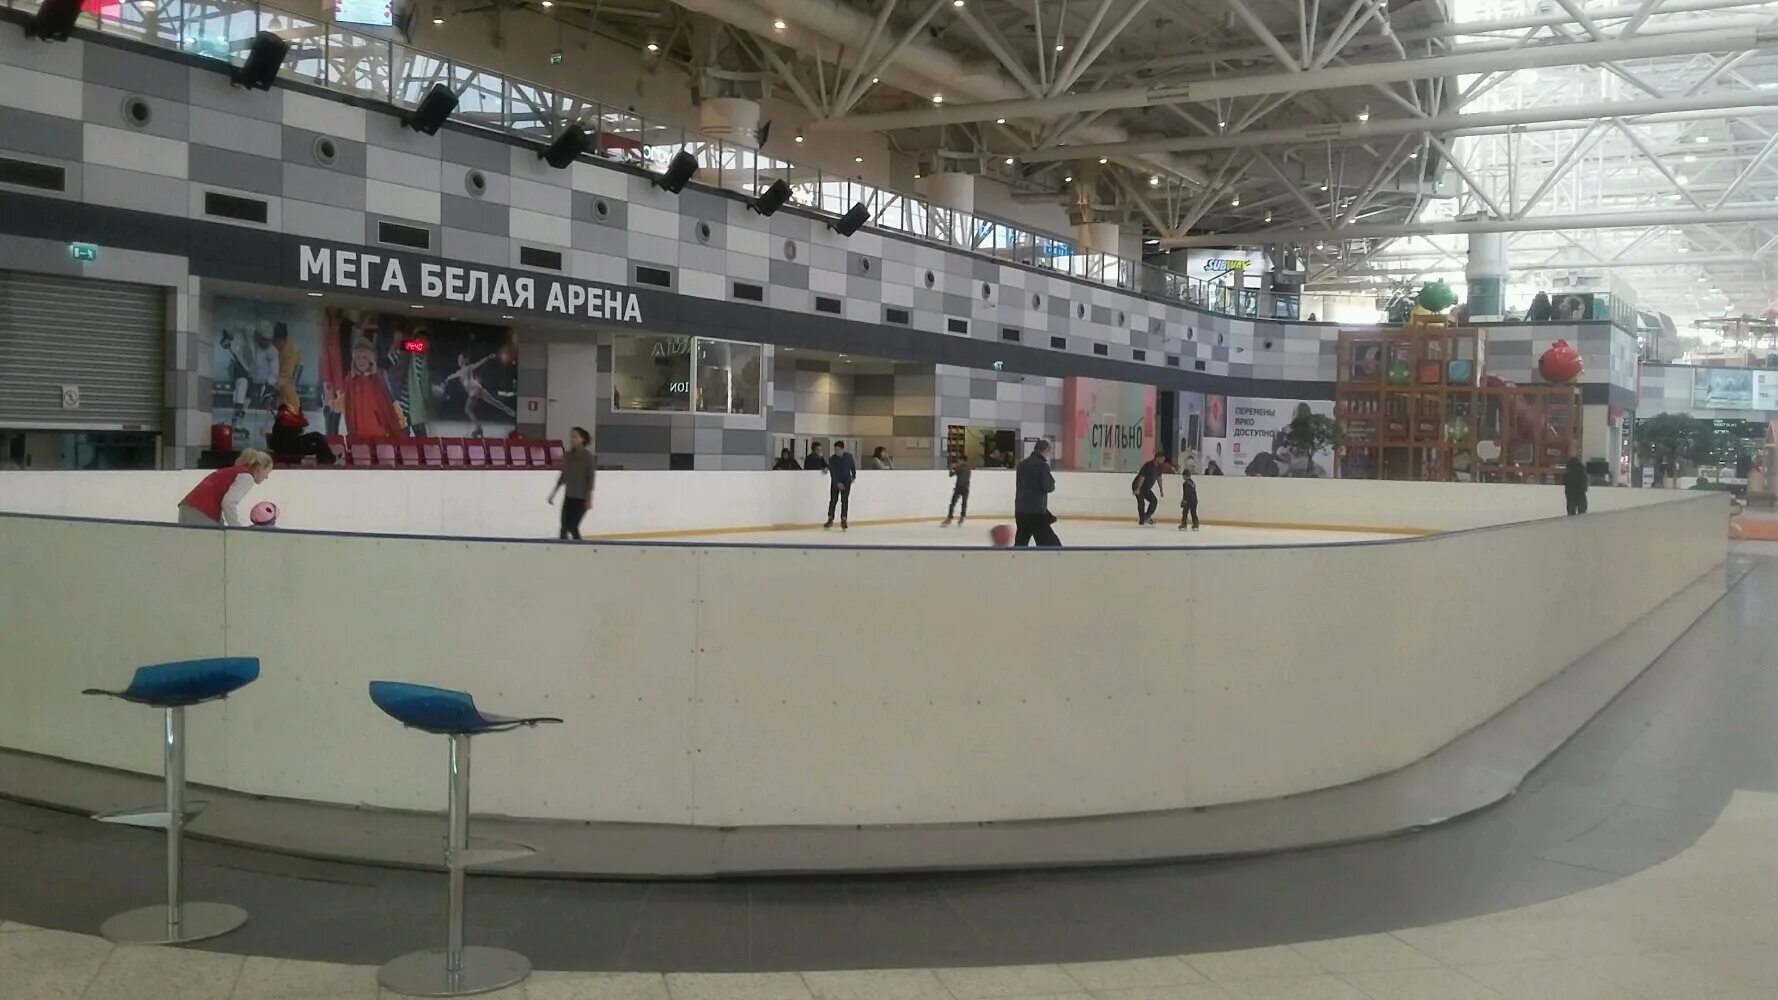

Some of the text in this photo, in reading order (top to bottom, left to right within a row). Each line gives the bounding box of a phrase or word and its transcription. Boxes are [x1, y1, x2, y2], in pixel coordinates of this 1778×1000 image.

[299, 245, 643, 324] МЕГА БЕЛАЯ АРЕНА
[1235, 406, 1276, 417] ПЕРЕМЕНЫ
[1234, 417, 1255, 426] ЯРКО
[1091, 422, 1144, 449] СТИЛЬНО
[1233, 428, 1275, 438] ДОСТУПНО
